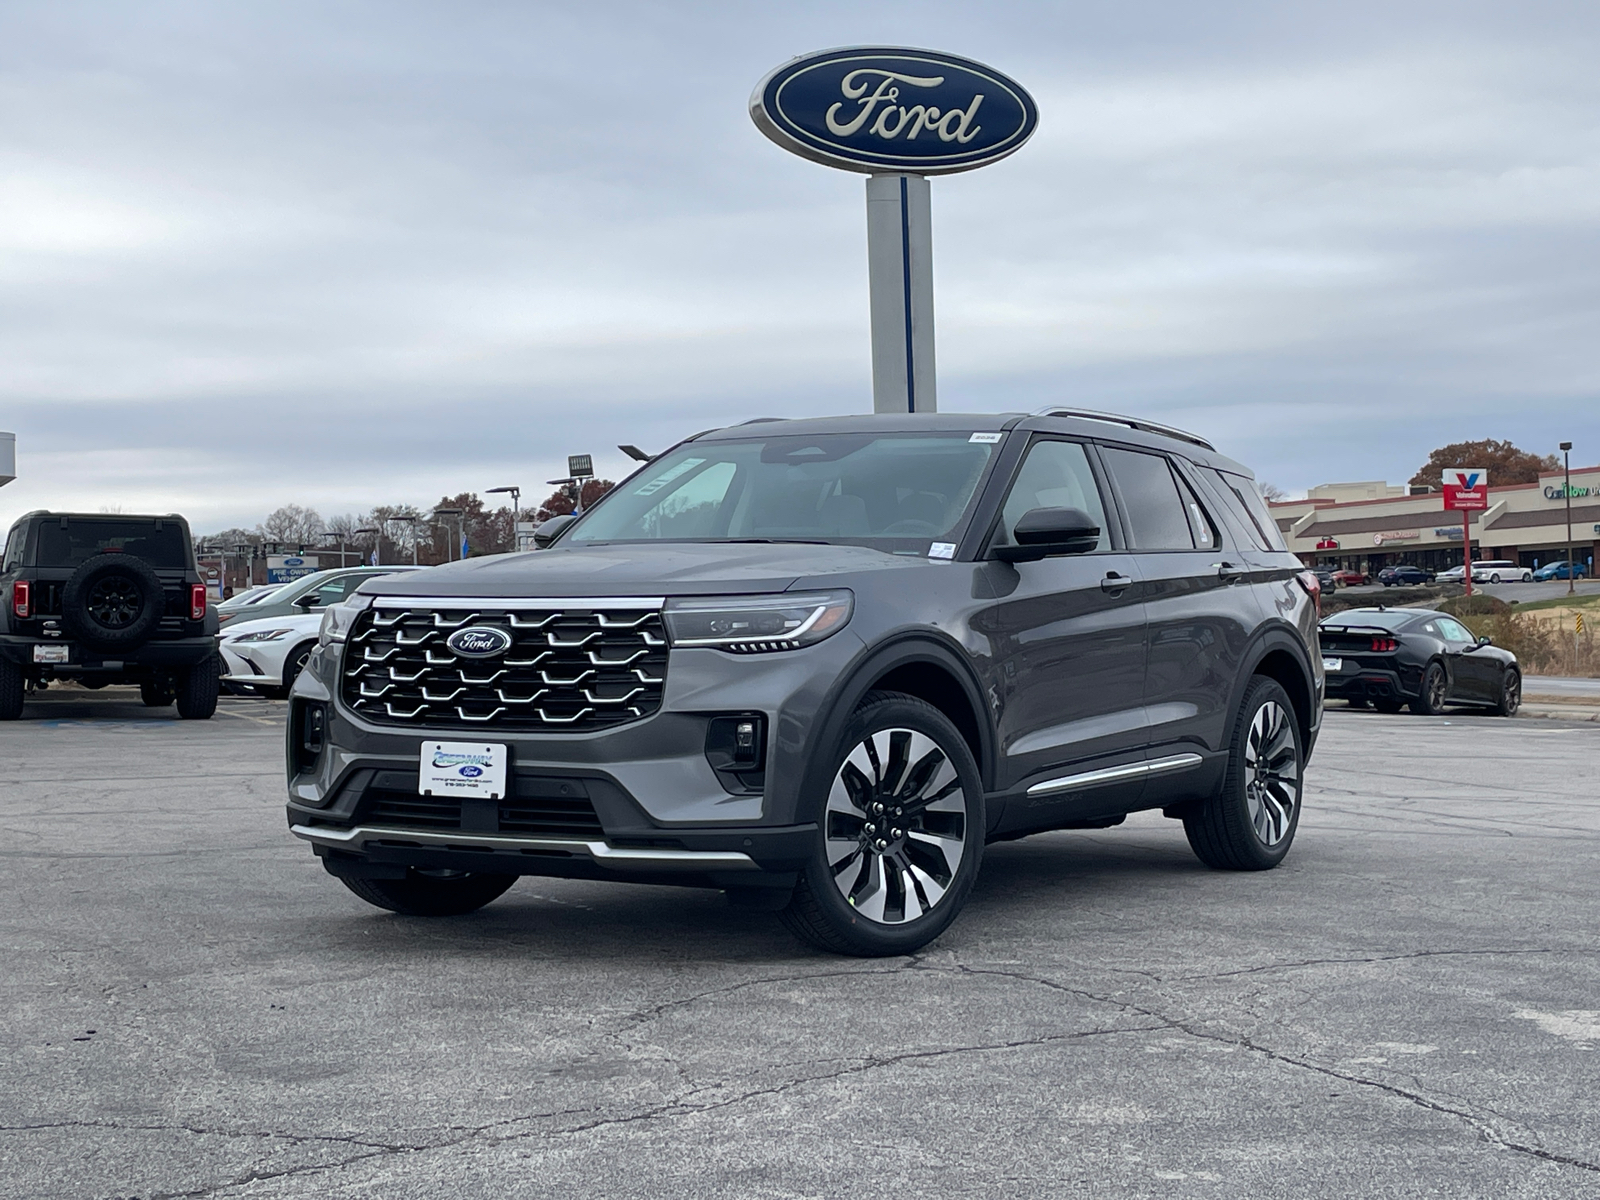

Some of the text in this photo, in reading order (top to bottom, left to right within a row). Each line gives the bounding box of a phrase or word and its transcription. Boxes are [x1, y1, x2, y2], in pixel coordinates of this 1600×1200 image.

[825, 68, 985, 144] Ford
[459, 632, 495, 650] Ford
[463, 767, 479, 776] Ford
